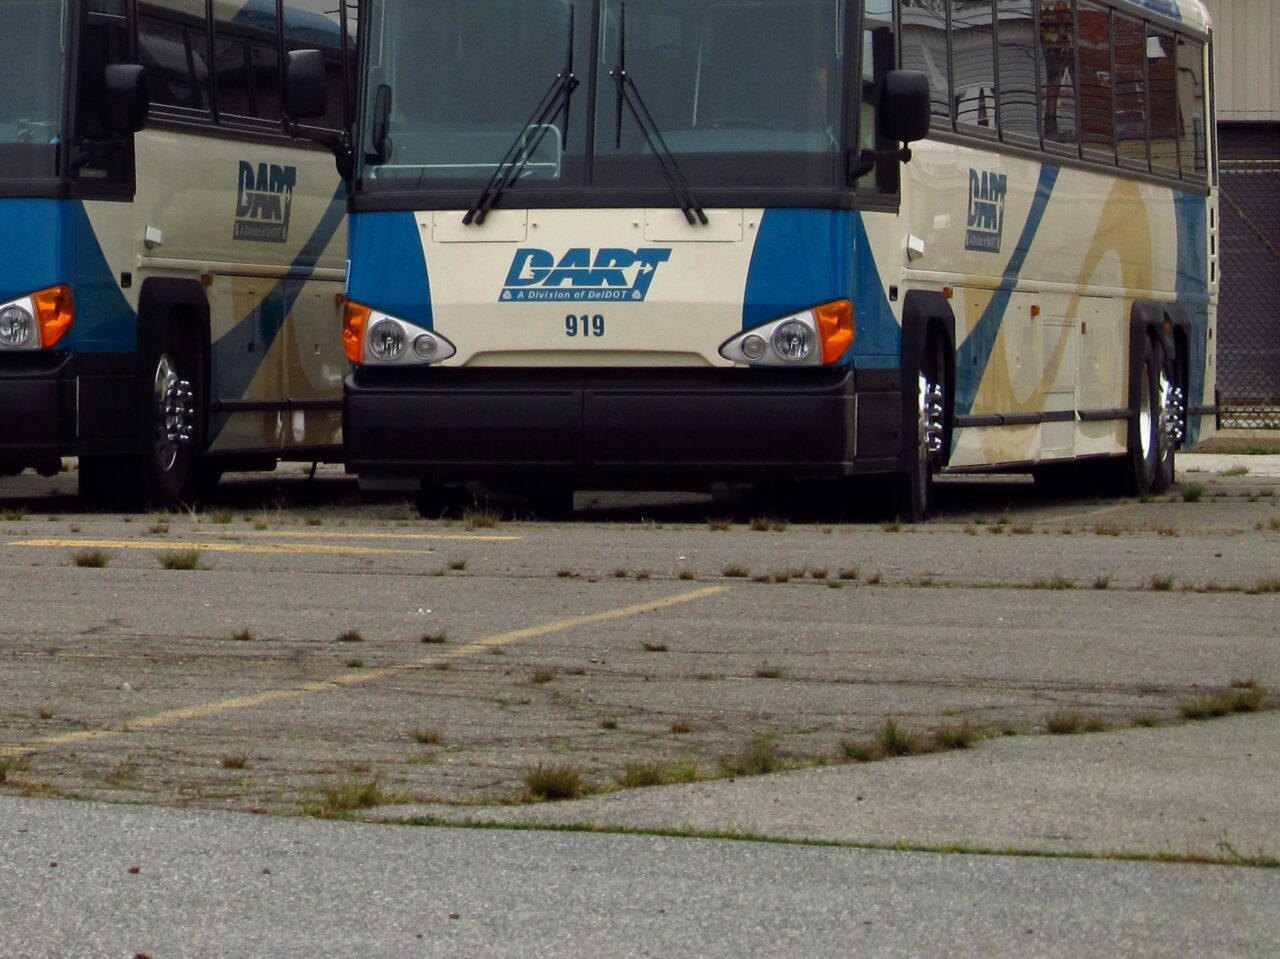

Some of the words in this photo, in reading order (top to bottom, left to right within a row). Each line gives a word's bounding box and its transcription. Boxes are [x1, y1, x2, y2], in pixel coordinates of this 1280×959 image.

[235, 160, 297, 221] DART
[966, 167, 1008, 231] DART
[503, 247, 673, 289] DART
[516, 291, 525, 299] A
[527, 290, 571, 299] Division
[573, 290, 585, 299] of
[587, 290, 628, 299] DelDOT
[564, 314, 605, 338] 919
